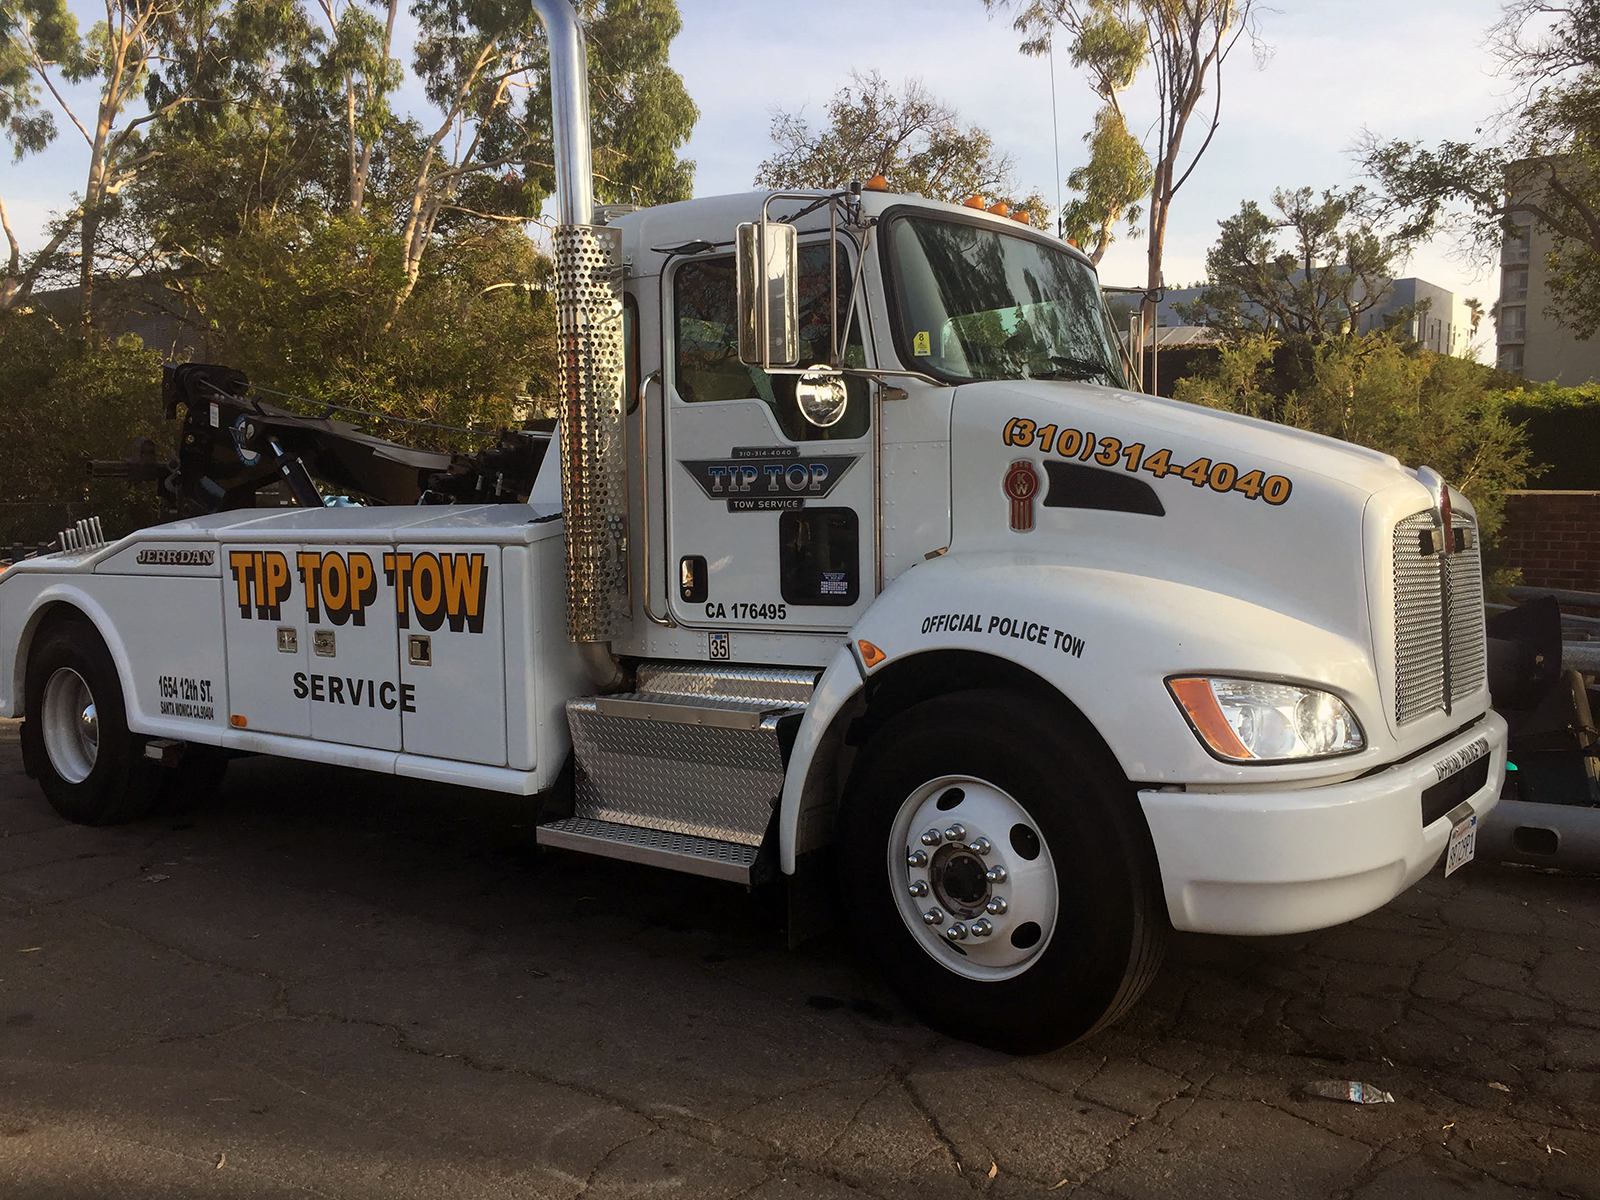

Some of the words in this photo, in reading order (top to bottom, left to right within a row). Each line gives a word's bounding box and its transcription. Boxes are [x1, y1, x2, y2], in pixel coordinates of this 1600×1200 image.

[739, 449, 792, 457] 310-314-4040
[1003, 417, 1293, 506] (310)314-4040
[708, 465, 758, 492] TIP
[763, 463, 829, 491] TOP
[734, 500, 754, 508] TOW
[758, 500, 798, 508] SERVICE
[229, 551, 291, 621] TIP
[297, 551, 377, 627] TOP
[383, 551, 488, 634] TOW
[705, 602, 727, 619] CA
[731, 603, 787, 620] 176495
[711, 639, 727, 657] 35
[921, 614, 983, 635] OFFICIAL
[987, 615, 1050, 646] POLICE
[1053, 629, 1086, 659] TOW
[158, 675, 178, 698] 1654
[180, 677, 199, 701] 12th
[200, 679, 214, 703] ST.
[293, 671, 417, 713] SERVICE
[160, 701, 175, 715] SANTA
[175, 702, 193, 718] MONICA
